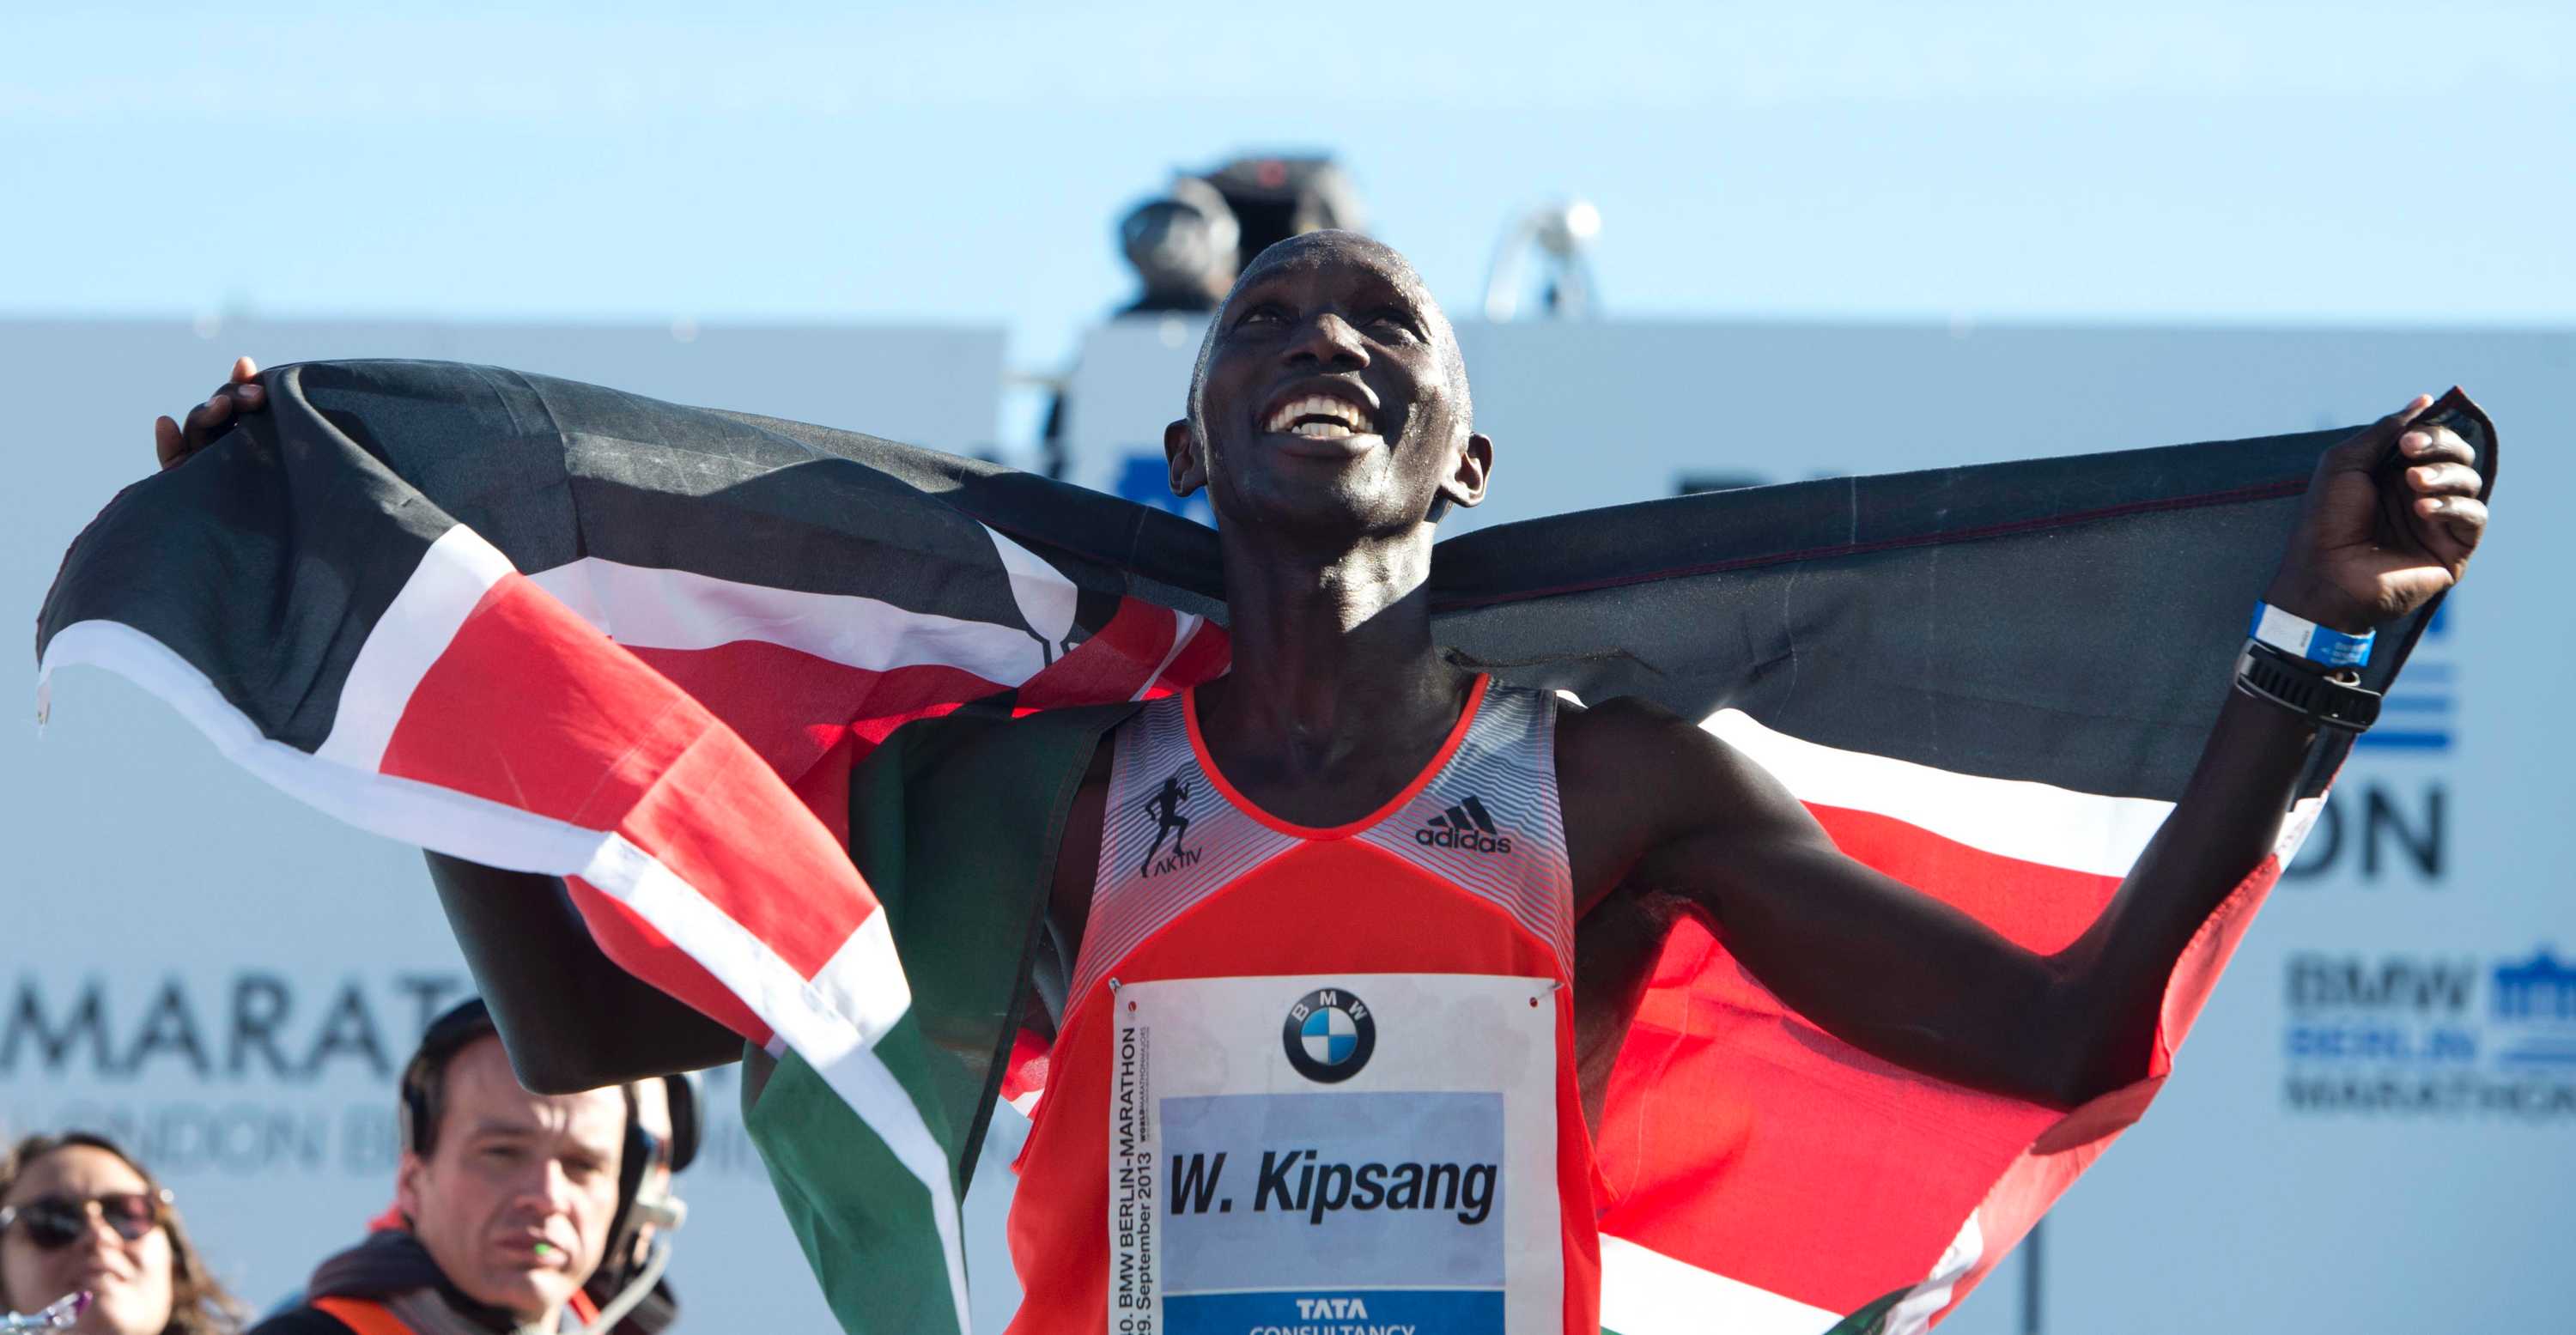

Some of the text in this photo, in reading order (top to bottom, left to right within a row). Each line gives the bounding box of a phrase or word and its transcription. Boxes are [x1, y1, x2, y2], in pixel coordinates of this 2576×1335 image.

[1415, 828, 1511, 853] adidas
[2284, 951, 2476, 1011] BMW
[1291, 991, 1368, 1022] BMW
[1119, 1027, 1135, 1335] 0. BMW BERLIN-MARATHON
[1170, 1149, 1497, 1226] W. Kipsang
[1136, 1151, 1153, 1335] 9. September 2013
[1249, 1325, 1416, 1335] CONSULTANCY
[1296, 1298, 1368, 1320] TATA
